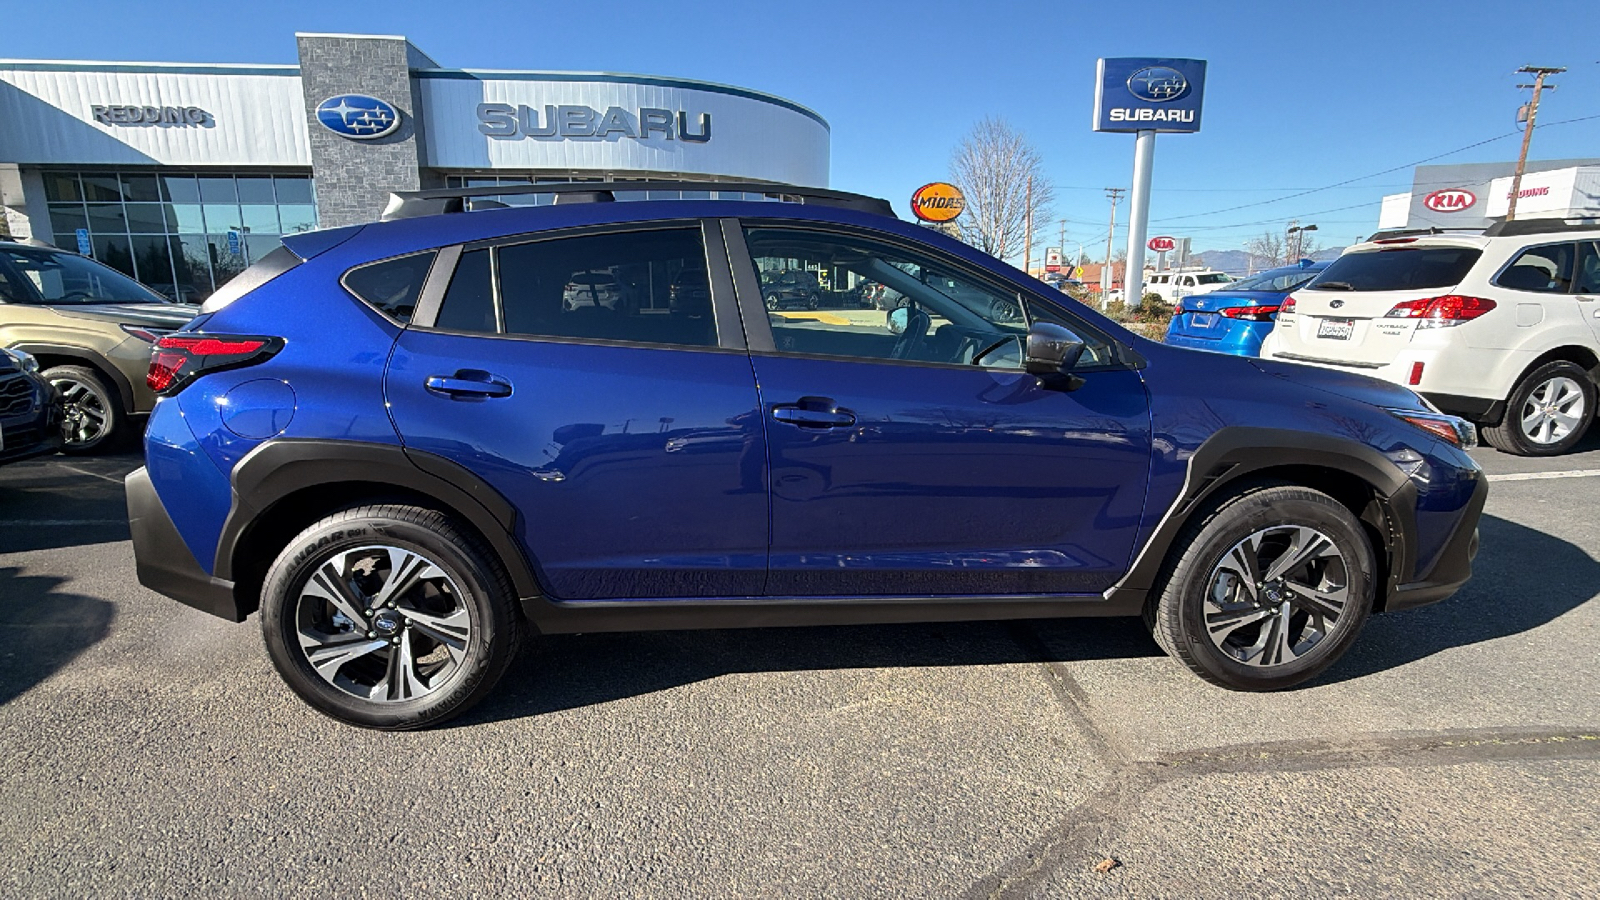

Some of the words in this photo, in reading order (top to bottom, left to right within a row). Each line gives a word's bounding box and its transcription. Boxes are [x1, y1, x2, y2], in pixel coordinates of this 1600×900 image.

[90, 104, 204, 124] REDDING
[1109, 108, 1194, 122] SUBARU
[477, 102, 712, 143] SUBARU
[1506, 186, 1550, 200] RDDING
[918, 192, 962, 209] MIDAS
[1432, 194, 1468, 208] KIA
[1153, 239, 1174, 249] KIA
